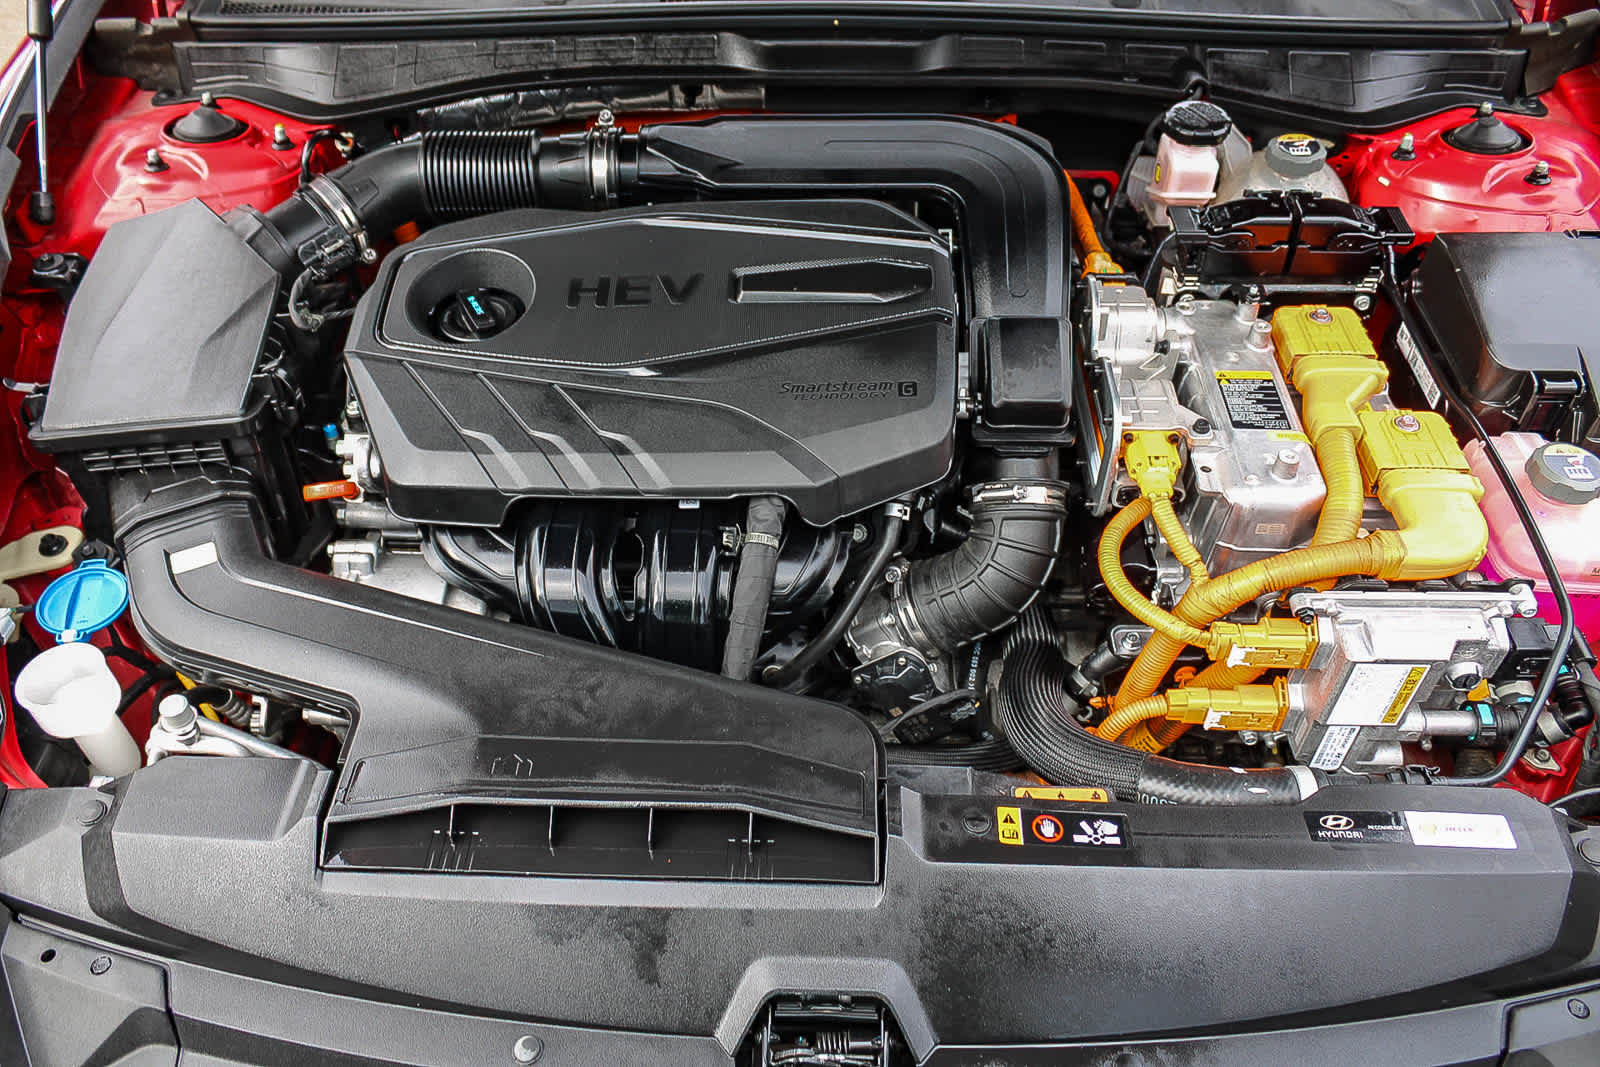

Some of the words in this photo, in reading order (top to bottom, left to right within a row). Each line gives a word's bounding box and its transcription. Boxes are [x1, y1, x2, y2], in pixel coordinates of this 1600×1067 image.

[566, 273, 704, 309] HEV
[778, 381, 895, 395] Smartstream
[899, 382, 917, 396] G
[793, 391, 890, 401] TECHNOLOGY
[1318, 830, 1364, 840] HYUNDAI
